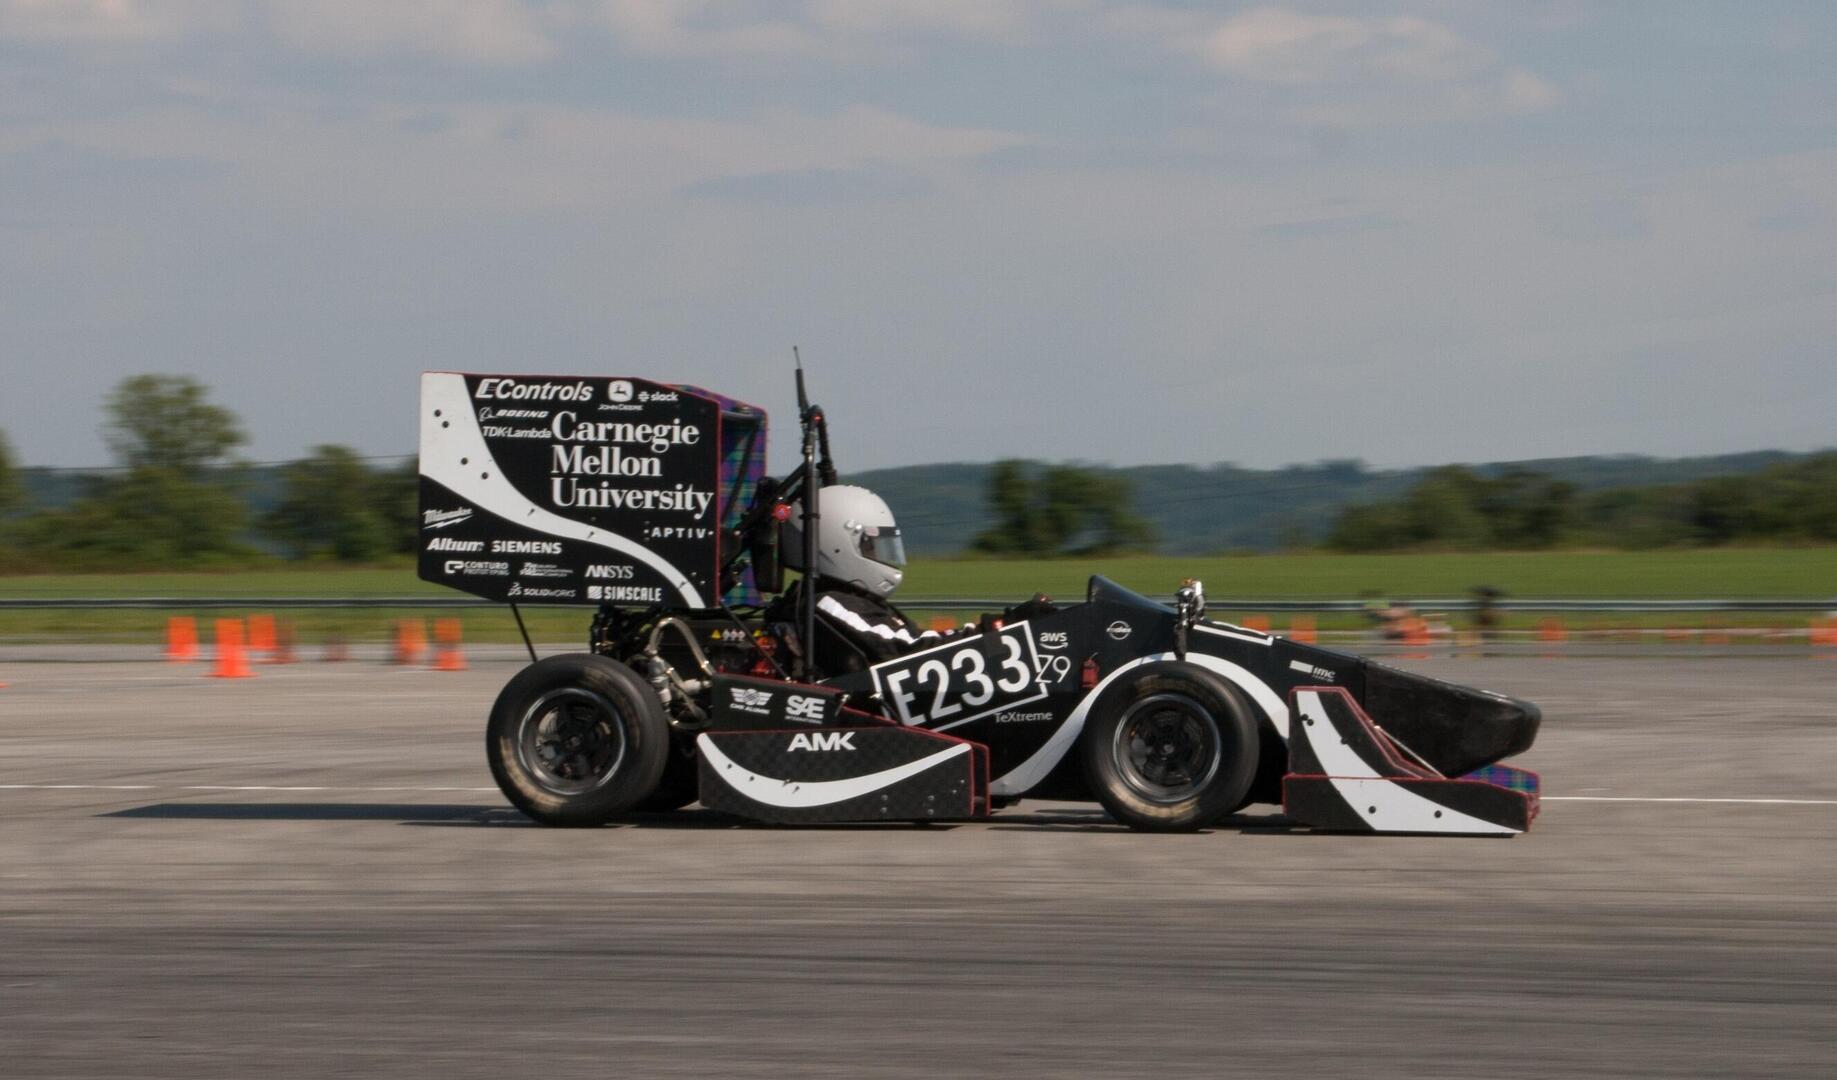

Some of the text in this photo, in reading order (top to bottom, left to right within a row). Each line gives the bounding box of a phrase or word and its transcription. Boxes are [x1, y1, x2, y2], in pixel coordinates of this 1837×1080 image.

[475, 378, 593, 401] EControls
[650, 391, 679, 402] slack
[496, 408, 549, 418] BOEING
[482, 425, 552, 438] TDK-Lambda
[551, 410, 700, 453] Carnegie
[551, 444, 663, 477] Mellon
[550, 477, 714, 520] University
[491, 540, 562, 554] SIEMENS
[463, 561, 509, 570] CONTURO
[584, 564, 634, 579] ANSYS
[603, 586, 662, 601] SIMSCALE
[1040, 632, 1068, 642] aws
[886, 634, 1031, 727] E233
[994, 711, 1054, 723] TeXtreme
[786, 731, 857, 752] AMK
